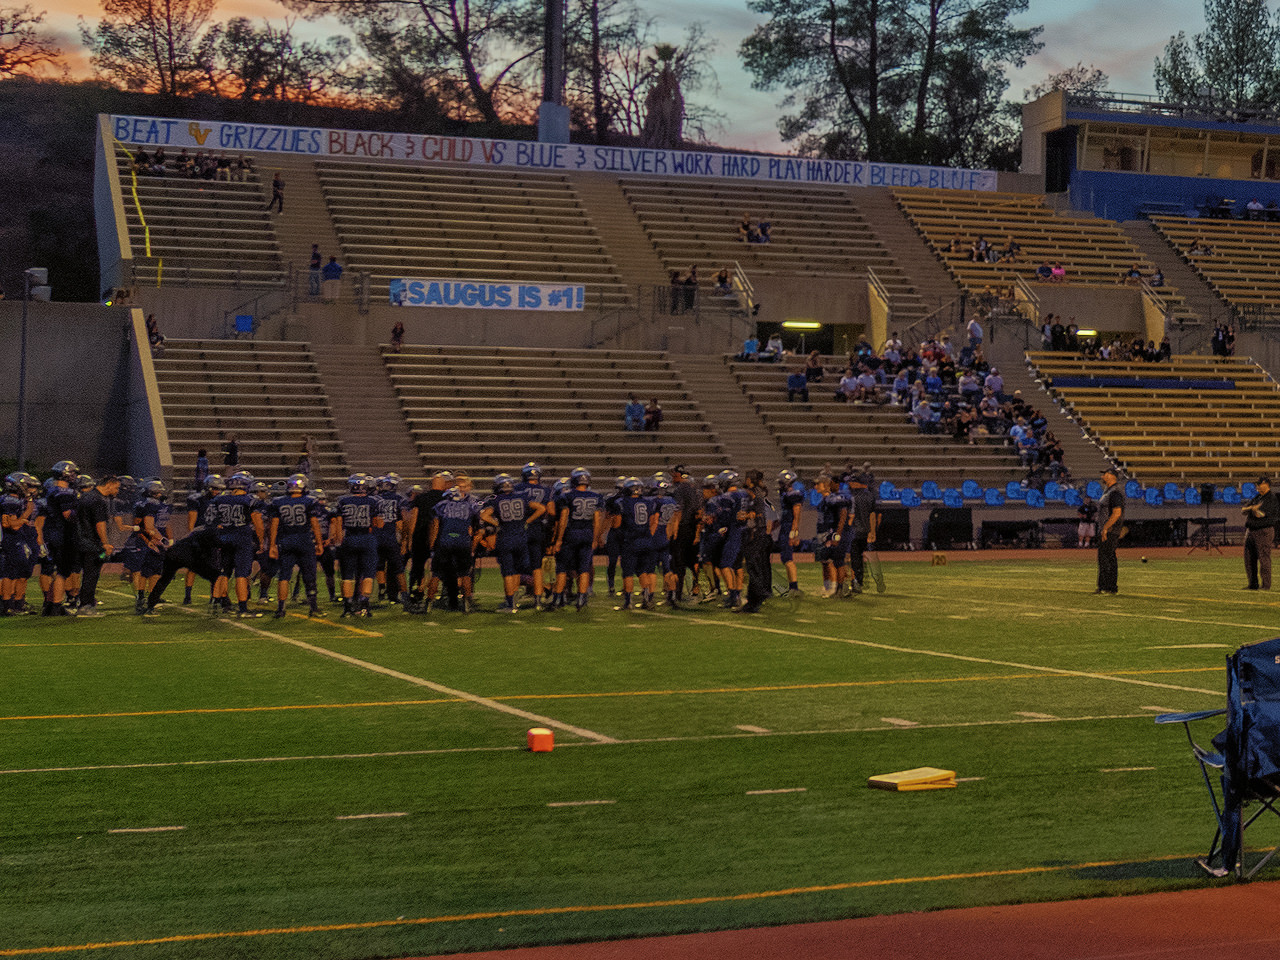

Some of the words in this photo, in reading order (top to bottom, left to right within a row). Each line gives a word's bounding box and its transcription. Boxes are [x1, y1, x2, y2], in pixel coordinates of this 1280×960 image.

[115, 116, 178, 144] BEAT
[328, 131, 394, 157] BLACK
[481, 140, 506, 165] VS
[516, 143, 567, 169] BLUE
[594, 147, 667, 173] SILVER
[671, 152, 713, 175] WORK
[721, 155, 761, 178] HARD
[768, 158, 801, 181] PLAY
[806, 159, 863, 184] HARDER
[870, 165, 922, 187] BLEED
[407, 281, 512, 308] SAUGUS
[518, 286, 542, 308] IS
[499, 498, 524, 521] 89
